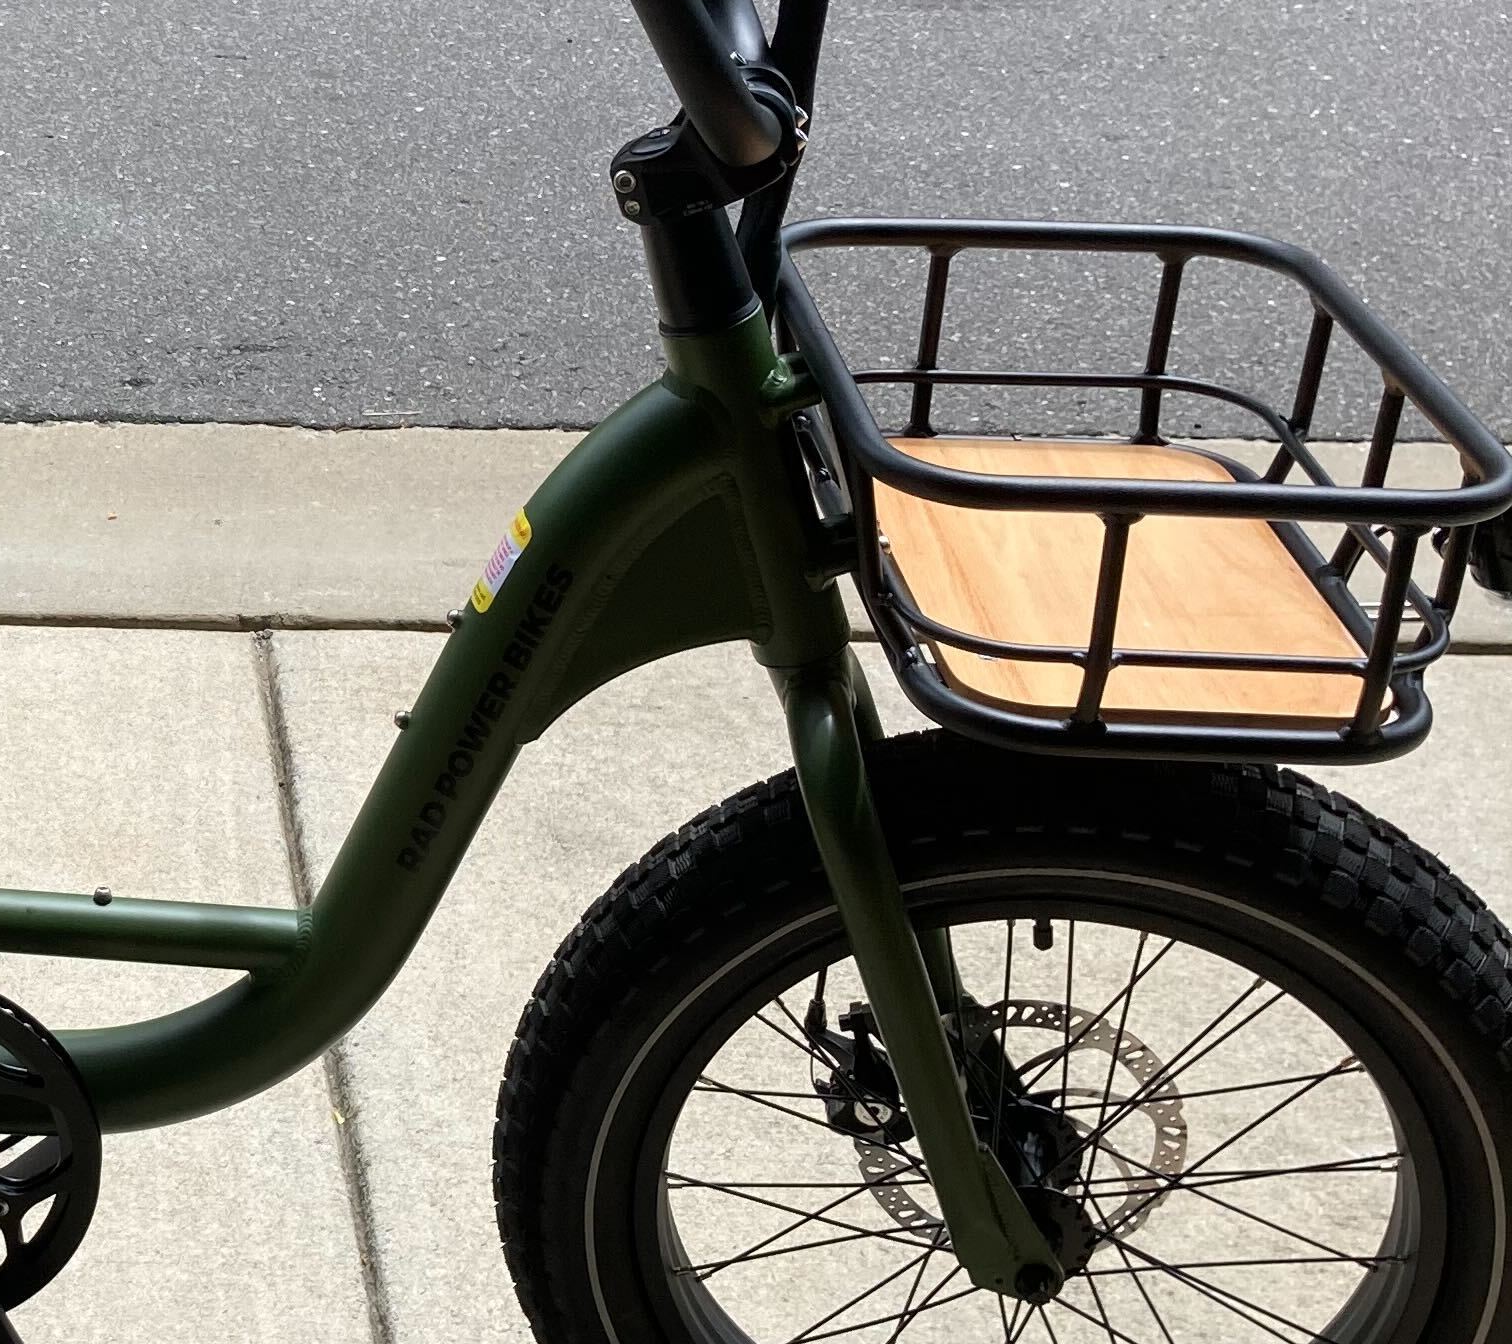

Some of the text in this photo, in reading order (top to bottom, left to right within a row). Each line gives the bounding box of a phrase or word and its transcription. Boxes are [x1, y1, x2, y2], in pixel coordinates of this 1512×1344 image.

[397, 563, 574, 872] RAD POWER BIKES
